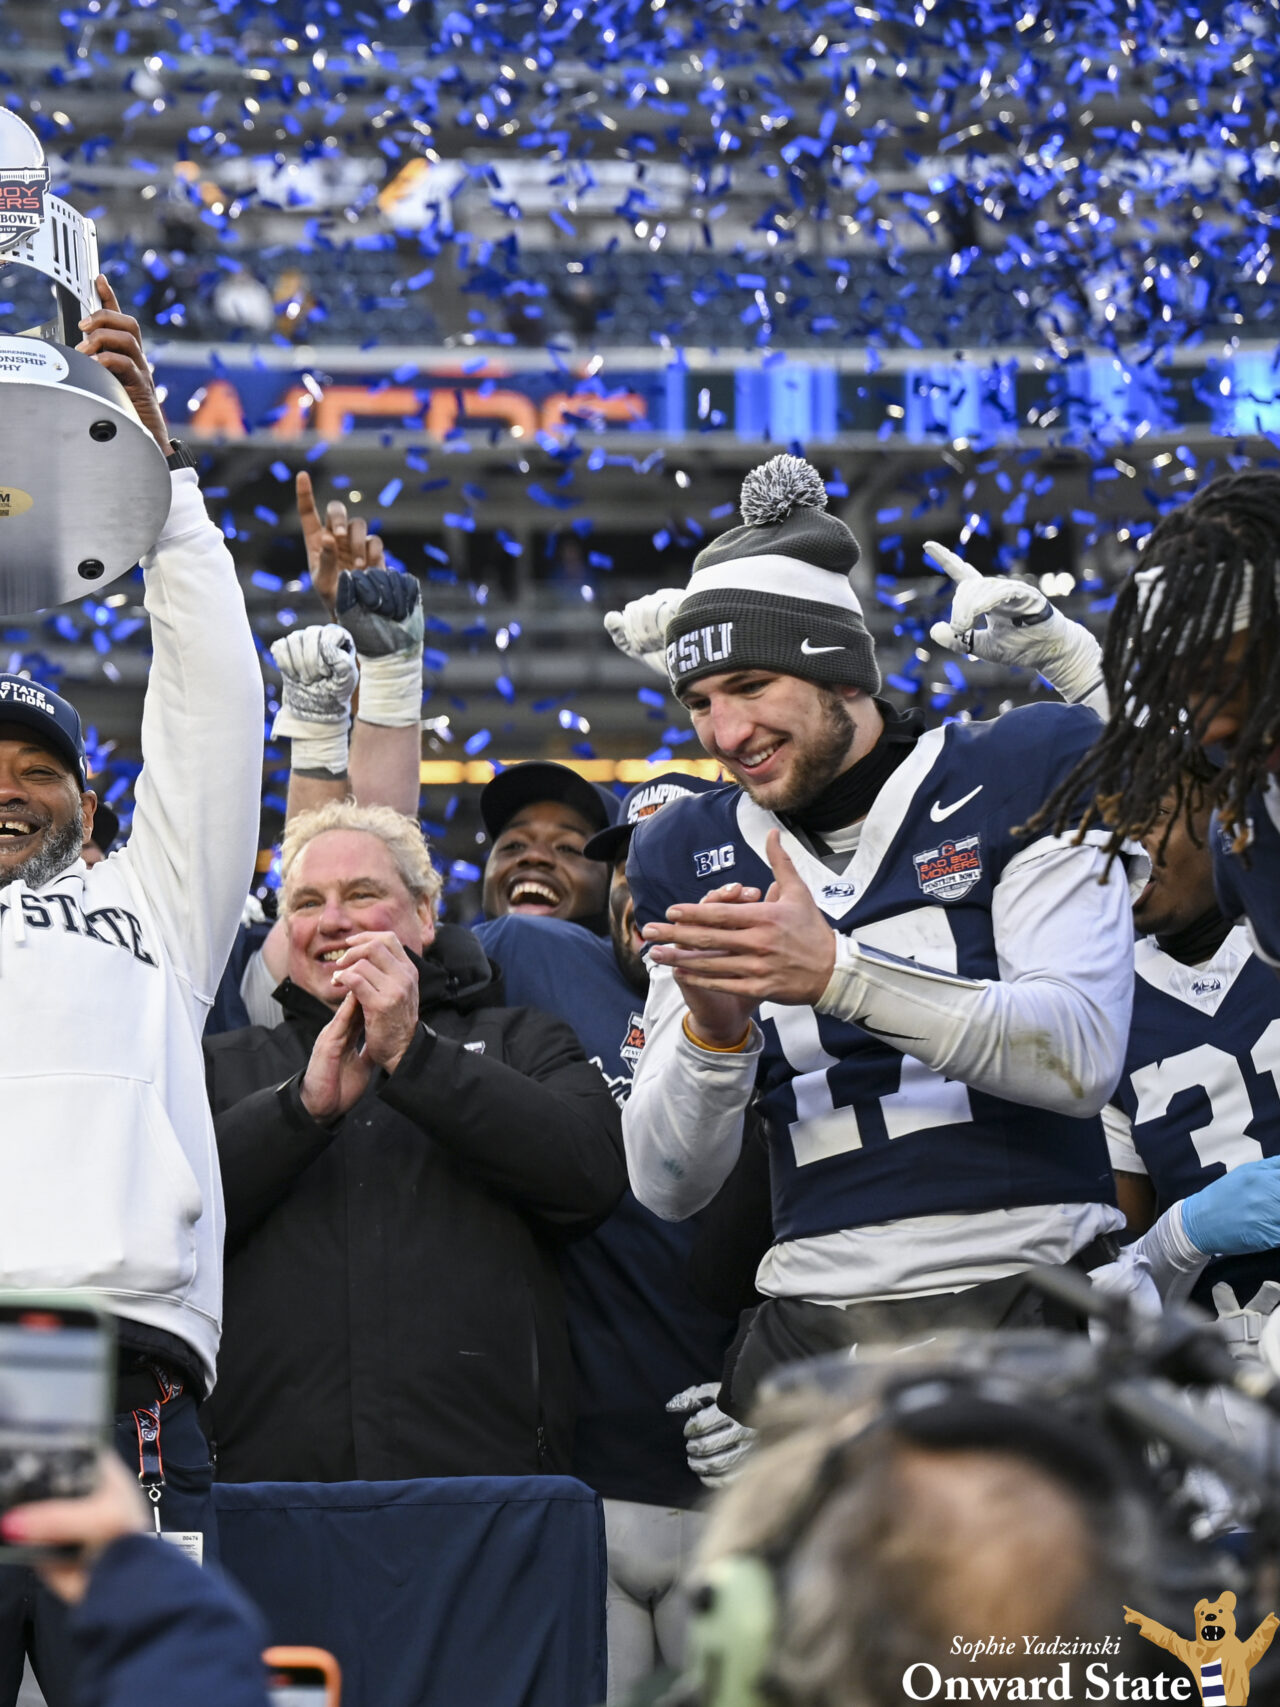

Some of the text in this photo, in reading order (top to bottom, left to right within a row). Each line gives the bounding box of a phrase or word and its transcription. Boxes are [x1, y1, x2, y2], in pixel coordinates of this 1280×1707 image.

[0, 213, 37, 225] BOWL
[666, 622, 733, 682] PSU
[0, 681, 46, 702] STATE
[12, 691, 56, 715] LIONS
[920, 849, 977, 873] BAD BOY
[920, 857, 979, 882] MOWERS
[19, 894, 160, 968] STATE
[1129, 1017, 1280, 1175] 3
